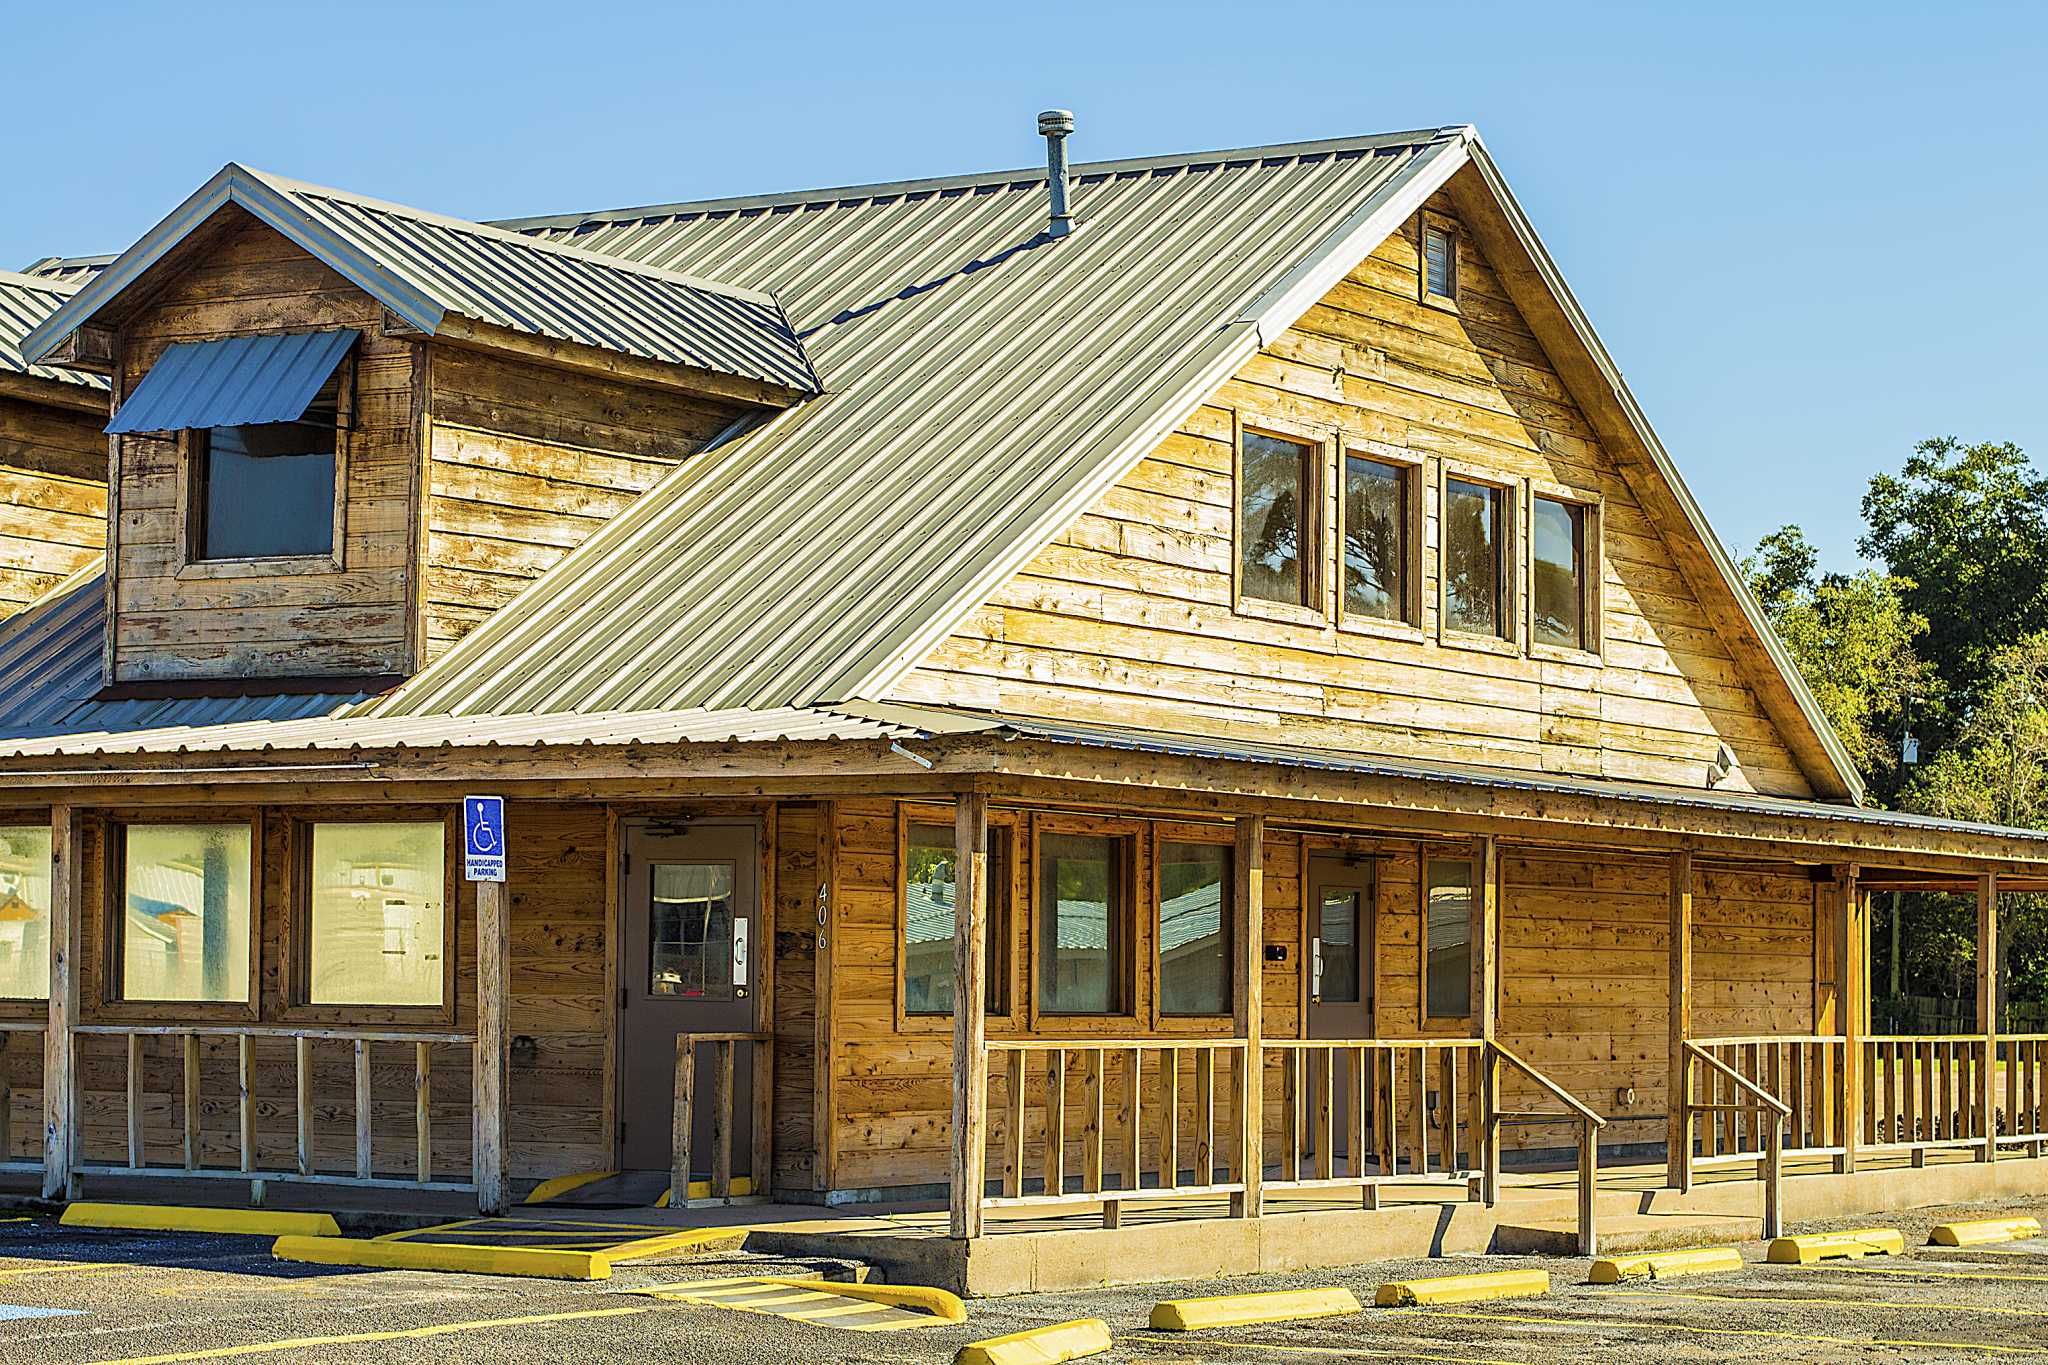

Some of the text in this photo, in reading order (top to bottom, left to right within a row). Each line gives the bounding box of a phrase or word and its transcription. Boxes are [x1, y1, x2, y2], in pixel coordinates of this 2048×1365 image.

[466, 859, 503, 868] HANDICAPPED
[473, 868, 498, 876] PARKING
[818, 882, 827, 949] 406
